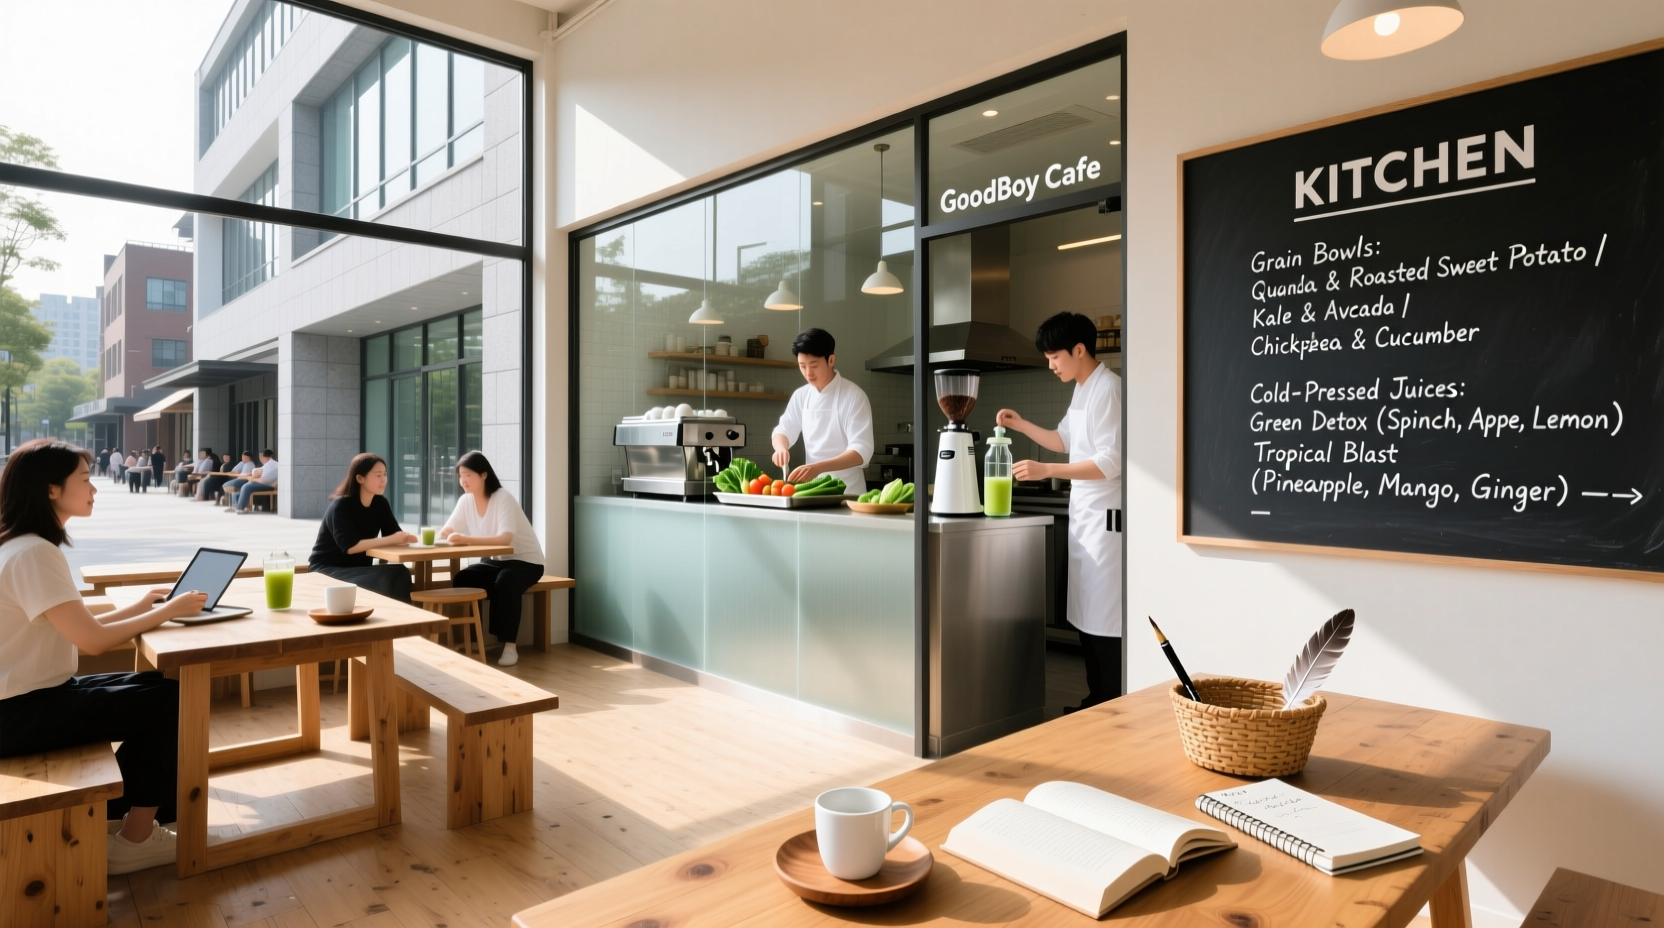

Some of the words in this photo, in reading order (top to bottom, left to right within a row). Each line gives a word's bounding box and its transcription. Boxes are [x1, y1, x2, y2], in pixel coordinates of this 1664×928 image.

[940, 174, 1040, 213] GoodBoy
[1045, 155, 1102, 189] Cafe
[1293, 124, 1536, 210] KITCHEN
[1251, 250, 1302, 273] Grain
[1313, 234, 1381, 265] Bowls:
[1325, 270, 1340, 292] &
[1349, 256, 1430, 289] Roasted
[1436, 250, 1499, 279] Sweet
[1508, 242, 1587, 271] Potato
[1252, 304, 1292, 329] Kale
[1300, 301, 1316, 323] &
[1351, 327, 1366, 350] &
[1374, 321, 1480, 348] Cucumber
[1250, 377, 1380, 404] Cold-Pressed
[1389, 375, 1466, 399] Juices:
[1250, 411, 1302, 433] Green
[1311, 411, 1368, 431] Detox
[1376, 405, 1463, 438] (Spinch,
[1467, 406, 1525, 438] Appe,
[1532, 400, 1624, 437] Lemon)
[1253, 440, 1333, 470] Tropical
[1342, 440, 1399, 464] Blast
[1251, 467, 1369, 502] (Pineapple,
[1378, 472, 1460, 508] Mango,
[1471, 472, 1569, 513] Ginger)
